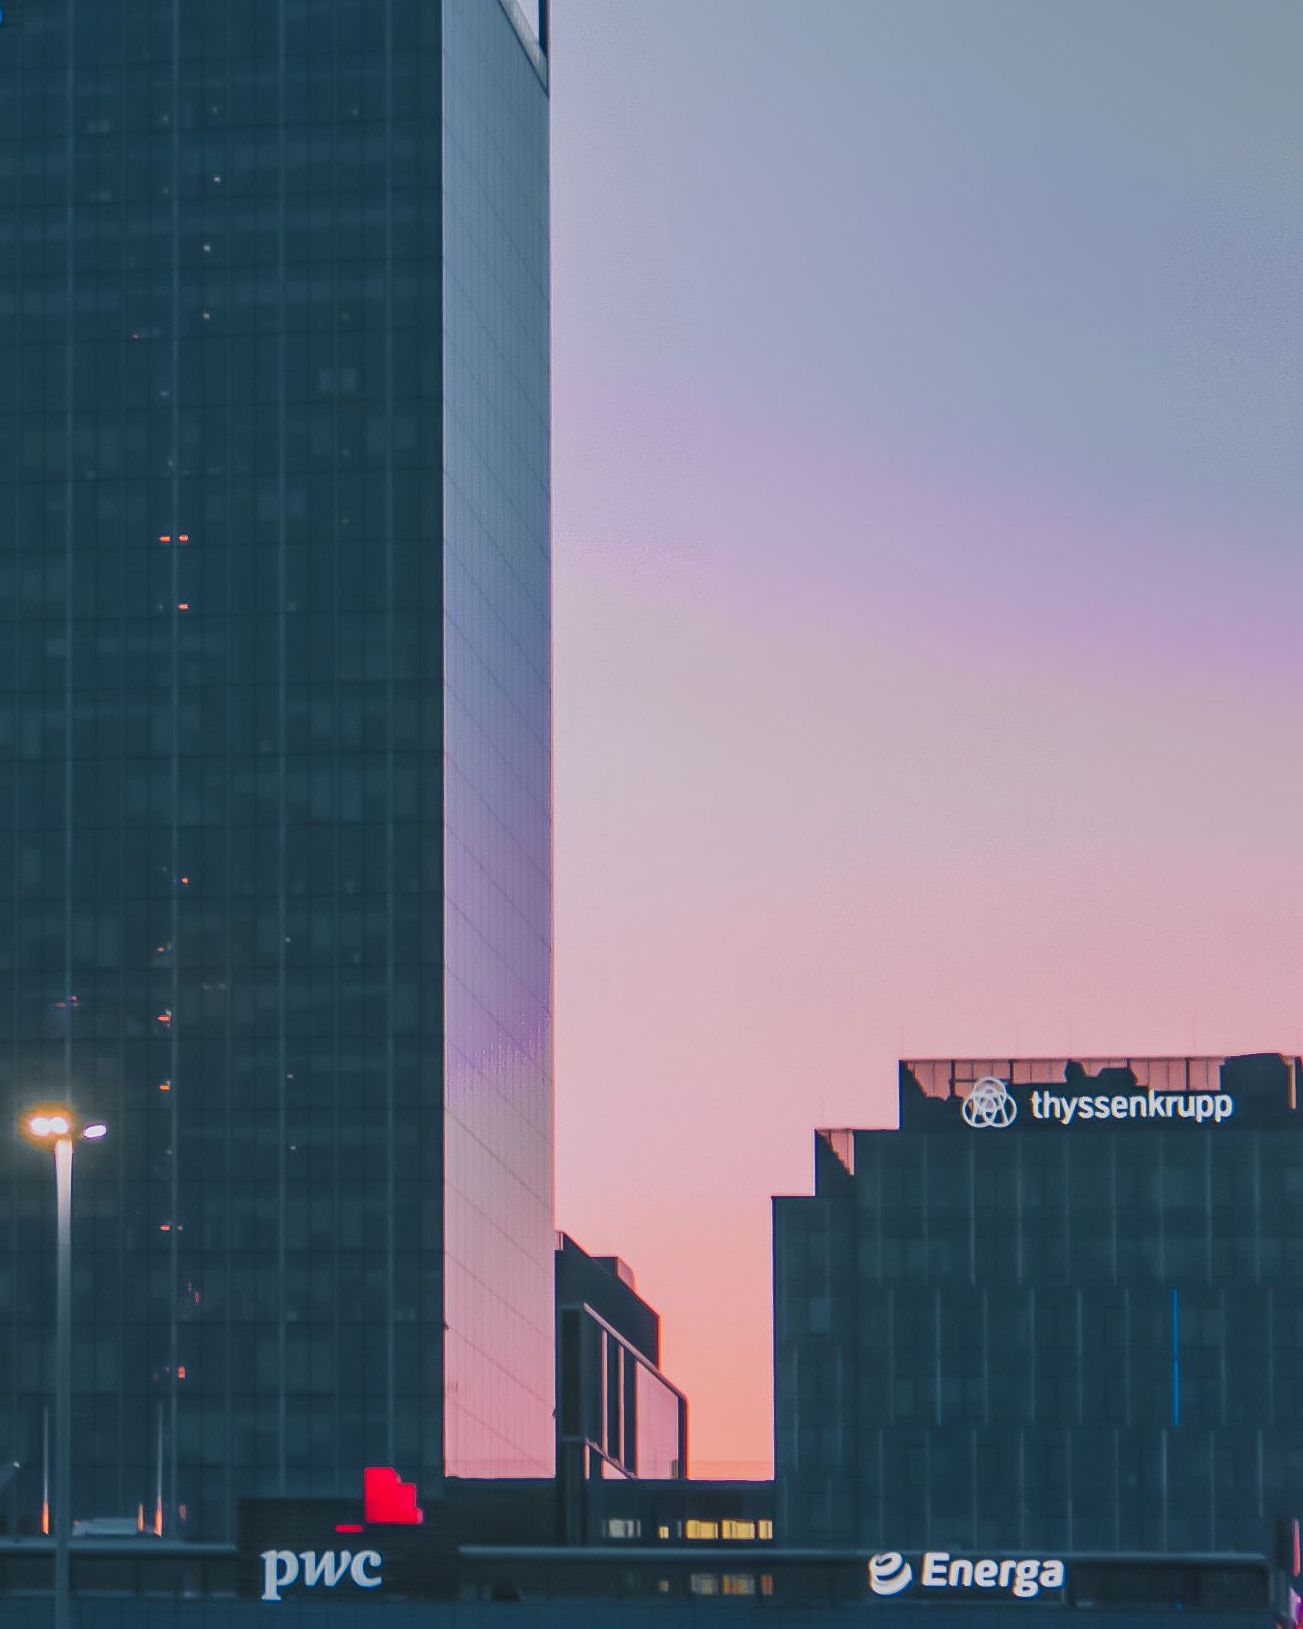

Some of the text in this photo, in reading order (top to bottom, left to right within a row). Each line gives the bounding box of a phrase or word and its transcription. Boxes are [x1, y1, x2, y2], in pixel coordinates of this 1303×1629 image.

[1031, 1089, 1233, 1125] thyssenkrupp
[260, 1549, 383, 1601] pwc
[922, 1551, 1065, 1598] Energa
